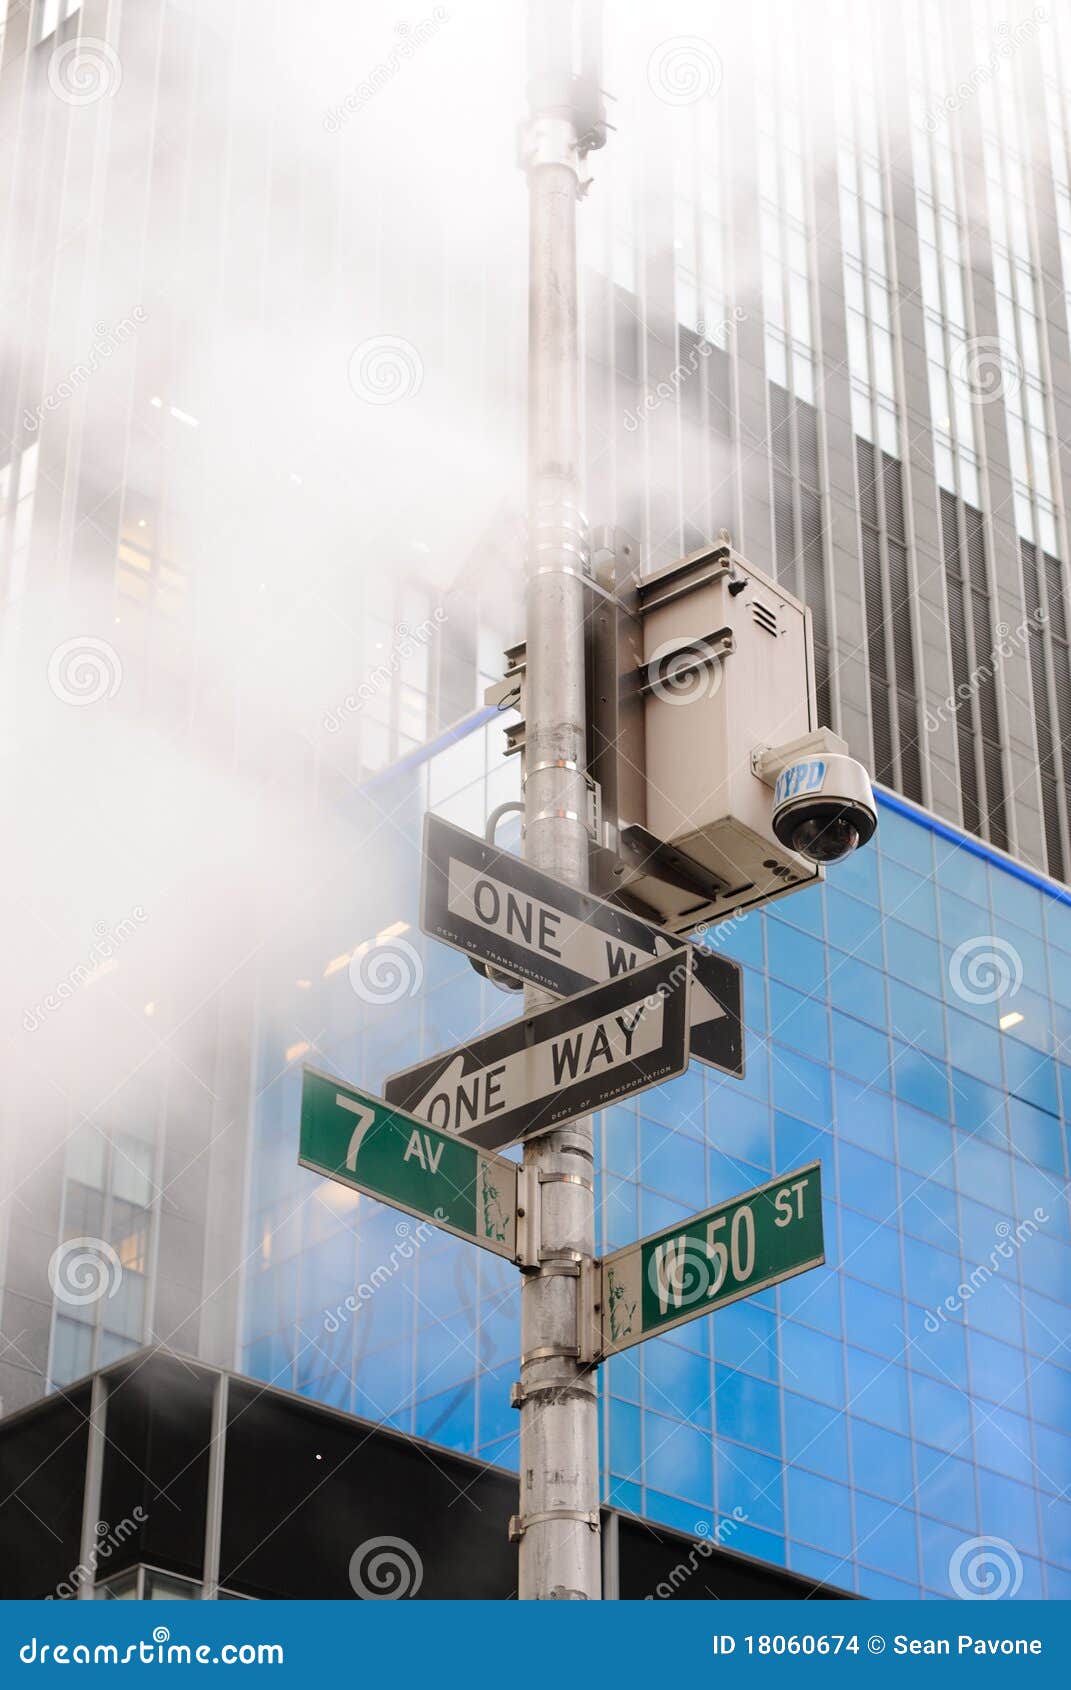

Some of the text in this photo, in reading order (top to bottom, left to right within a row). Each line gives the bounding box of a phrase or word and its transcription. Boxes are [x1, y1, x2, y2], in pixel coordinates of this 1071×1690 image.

[436, 926, 560, 990] DEPT OF TRANSPORTATION
[473, 880, 561, 958] ONE
[427, 1005, 645, 1129] ONE WAY
[551, 1064, 672, 1121] DEPT OF TRANSPORTATION
[335, 1093, 445, 1175] 7 AV
[654, 1179, 810, 1316] W 50 ST
